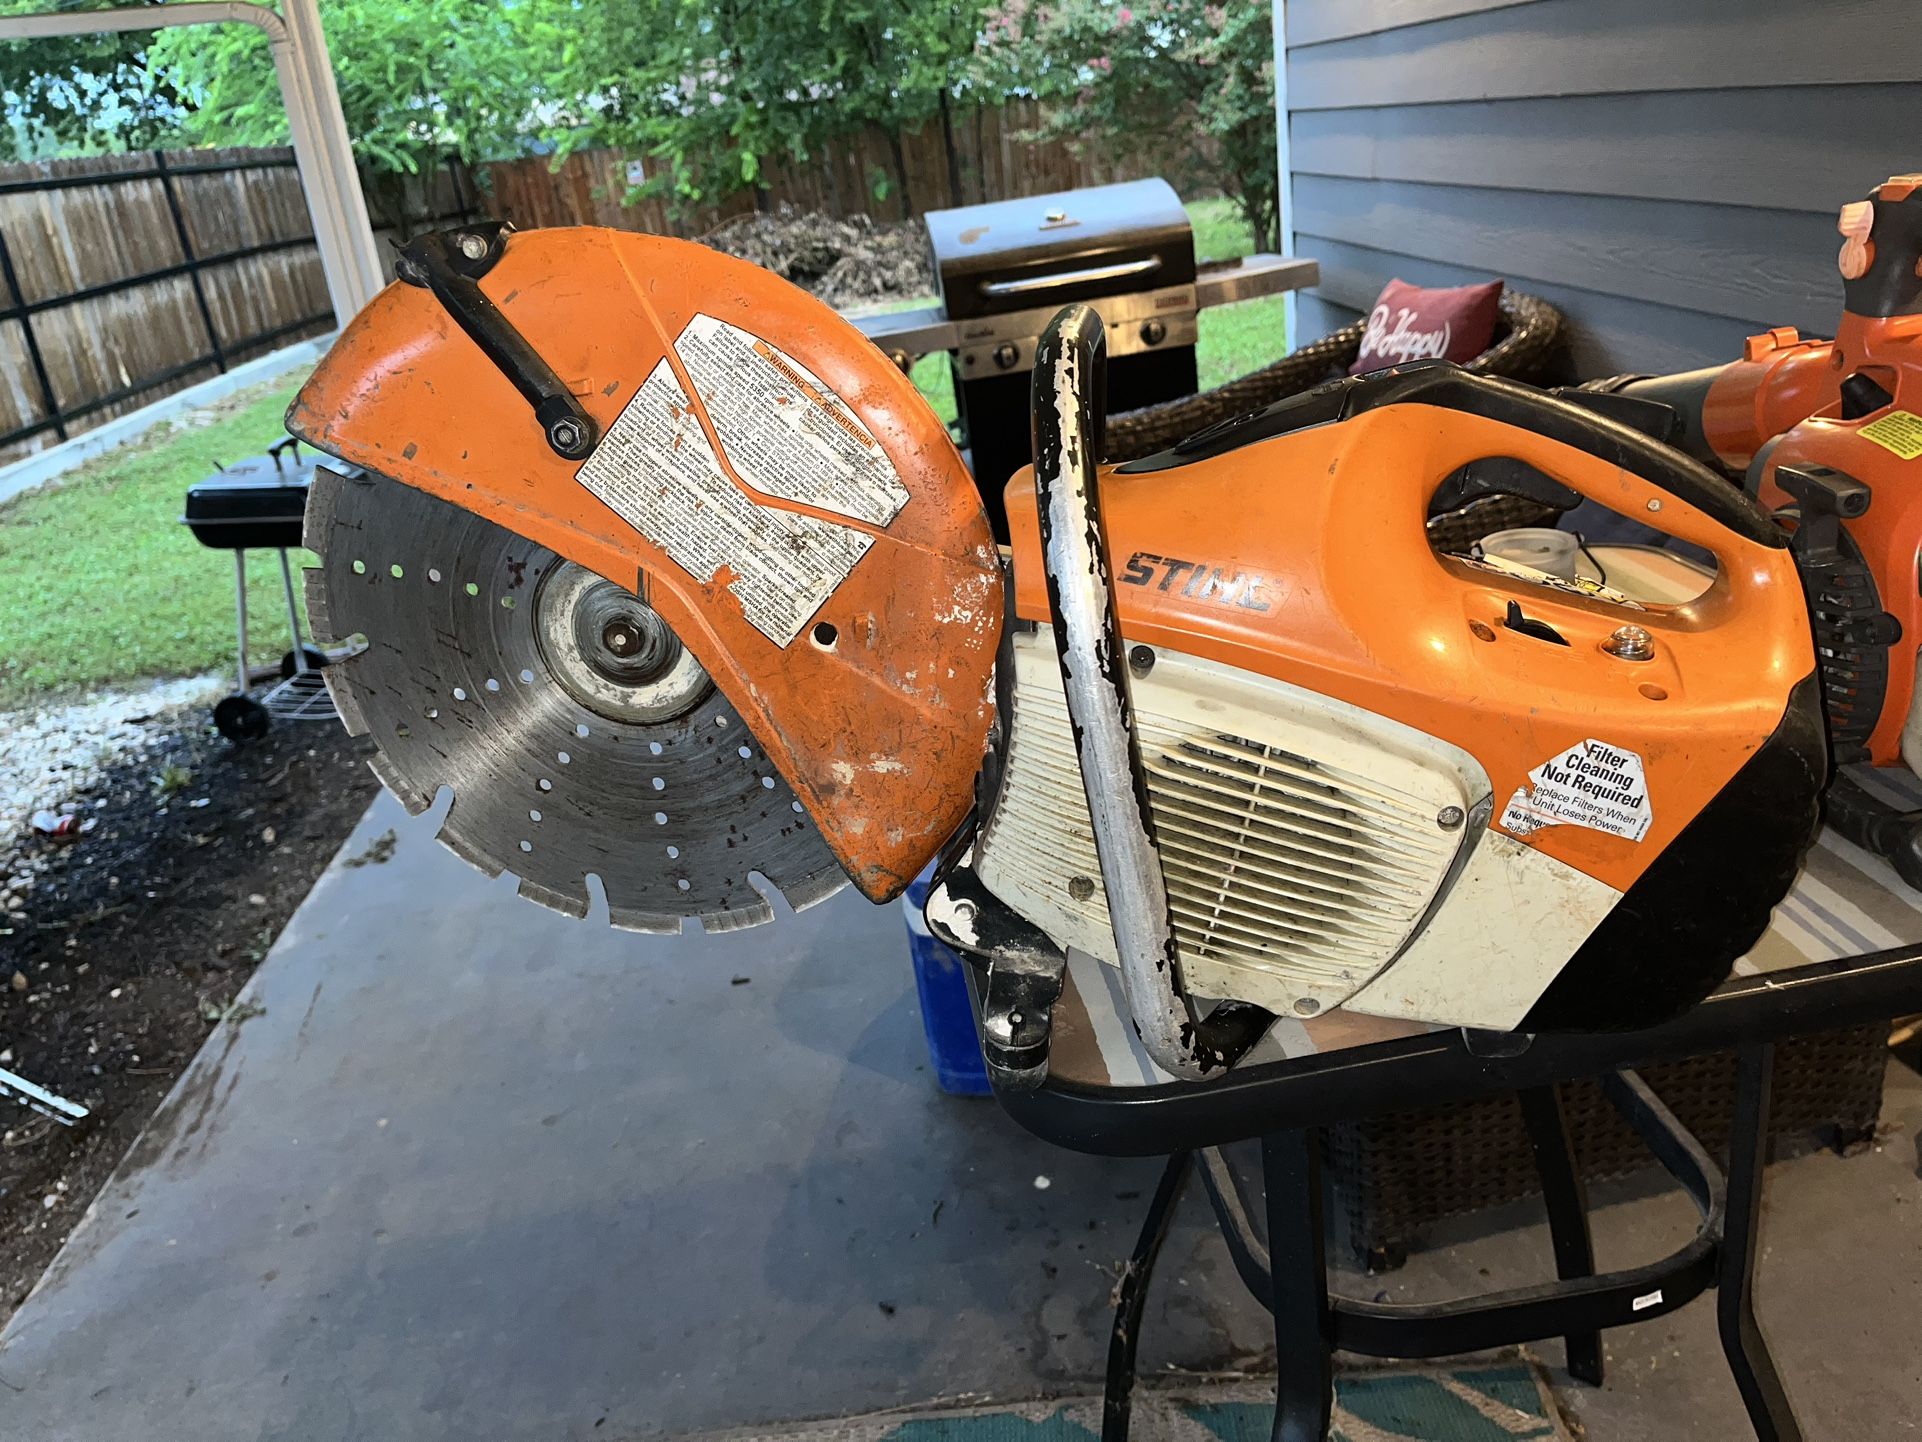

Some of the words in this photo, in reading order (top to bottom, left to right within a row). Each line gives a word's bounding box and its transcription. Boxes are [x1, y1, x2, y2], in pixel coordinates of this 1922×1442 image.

[691, 334, 716, 356] Maximum
[732, 369, 749, 386] speed
[748, 382, 765, 398] 5350
[711, 333, 730, 350] Failure
[749, 366, 765, 380] these
[717, 347, 733, 361] cause
[719, 323, 733, 337] Read
[763, 362, 780, 378] safety
[722, 334, 736, 347] label
[750, 358, 777, 383] instruction
[687, 338, 711, 361] Carefully
[709, 357, 726, 372] select
[734, 379, 746, 390] care
[752, 394, 774, 414] abrasive
[768, 354, 806, 389] WARNING
[639, 402, 661, 422] Reactive
[660, 419, 676, 435] forces
[691, 446, 710, 463] sudden
[736, 427, 751, 441] Other
[750, 439, 768, 456] wheels
[820, 400, 873, 448] ADVERTENCIA
[629, 402, 650, 421] slowing
[654, 423, 675, 442] binding
[688, 451, 703, 465] wheel
[712, 473, 728, 486] cause
[650, 435, 666, 450] wheel
[664, 447, 681, 462] where
[716, 482, 734, 499] reduce
[732, 496, 743, 506] risk
[1565, 754, 1634, 791] Cleaning
[1586, 743, 1628, 769] Filter
[1541, 764, 1571, 786] Not
[1572, 775, 1643, 809] Required
[1508, 810, 1522, 820] No
[1532, 796, 1554, 812] Unit
[1556, 806, 1586, 822] Loses
[1572, 796, 1605, 814] Filters
[1606, 808, 1637, 825] When
